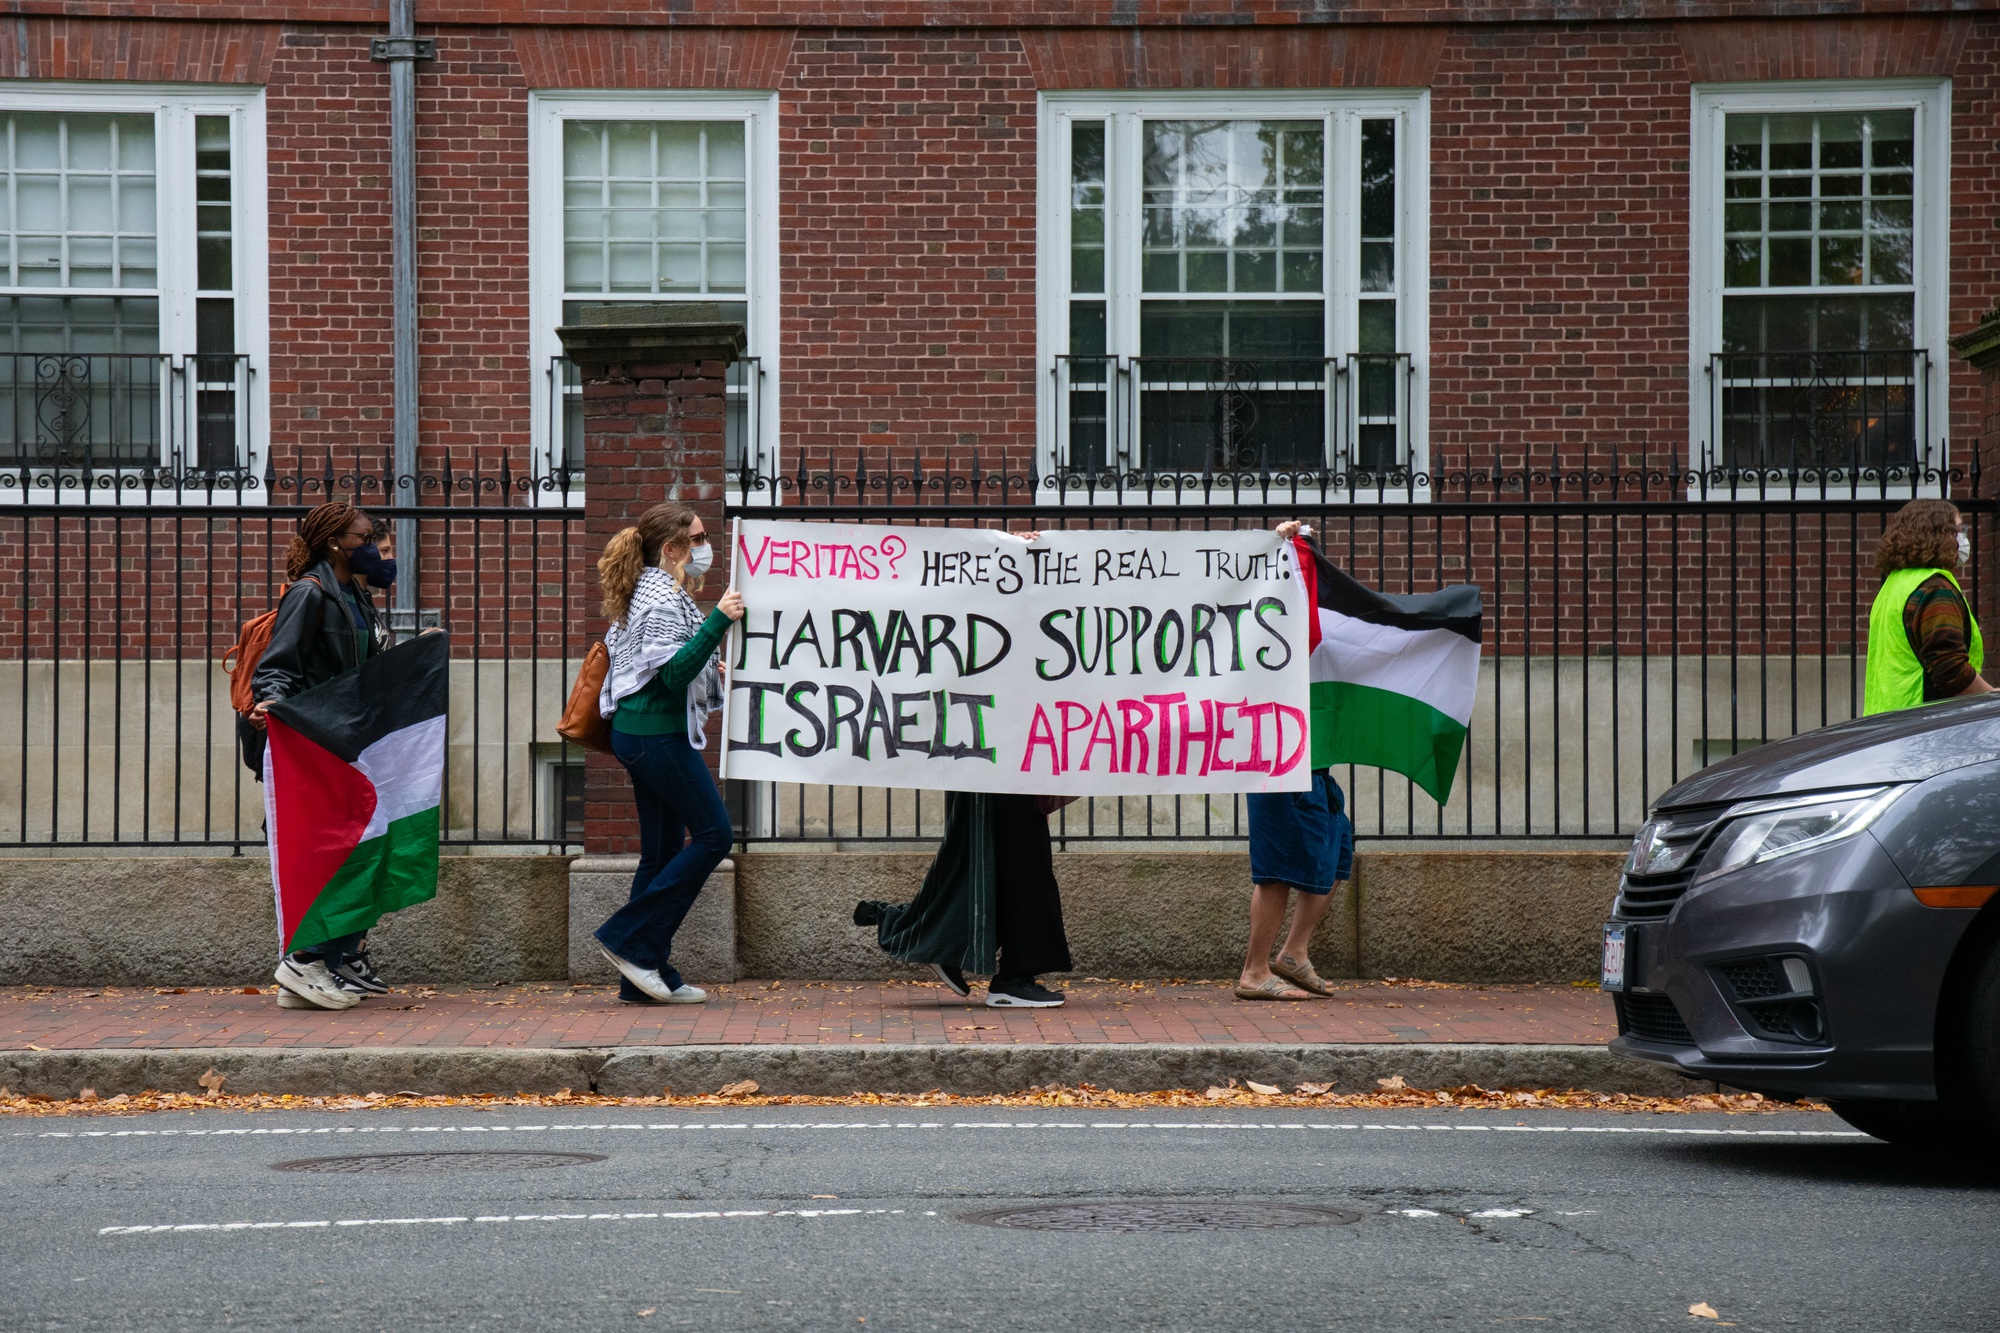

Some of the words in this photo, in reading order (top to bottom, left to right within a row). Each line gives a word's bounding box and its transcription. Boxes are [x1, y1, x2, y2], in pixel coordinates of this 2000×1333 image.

[739, 535, 907, 581] VERITAS?
[920, 546, 1023, 595] HERE'S
[1026, 547, 1081, 586] THE
[1092, 548, 1180, 586] REAL
[1196, 548, 1291, 581] TRUTH:
[735, 606, 1012, 678] HARVARD
[1035, 597, 1291, 682] SUPPORTS
[728, 679, 997, 764] ISRAELI
[1020, 692, 1308, 777] APARTHEID
